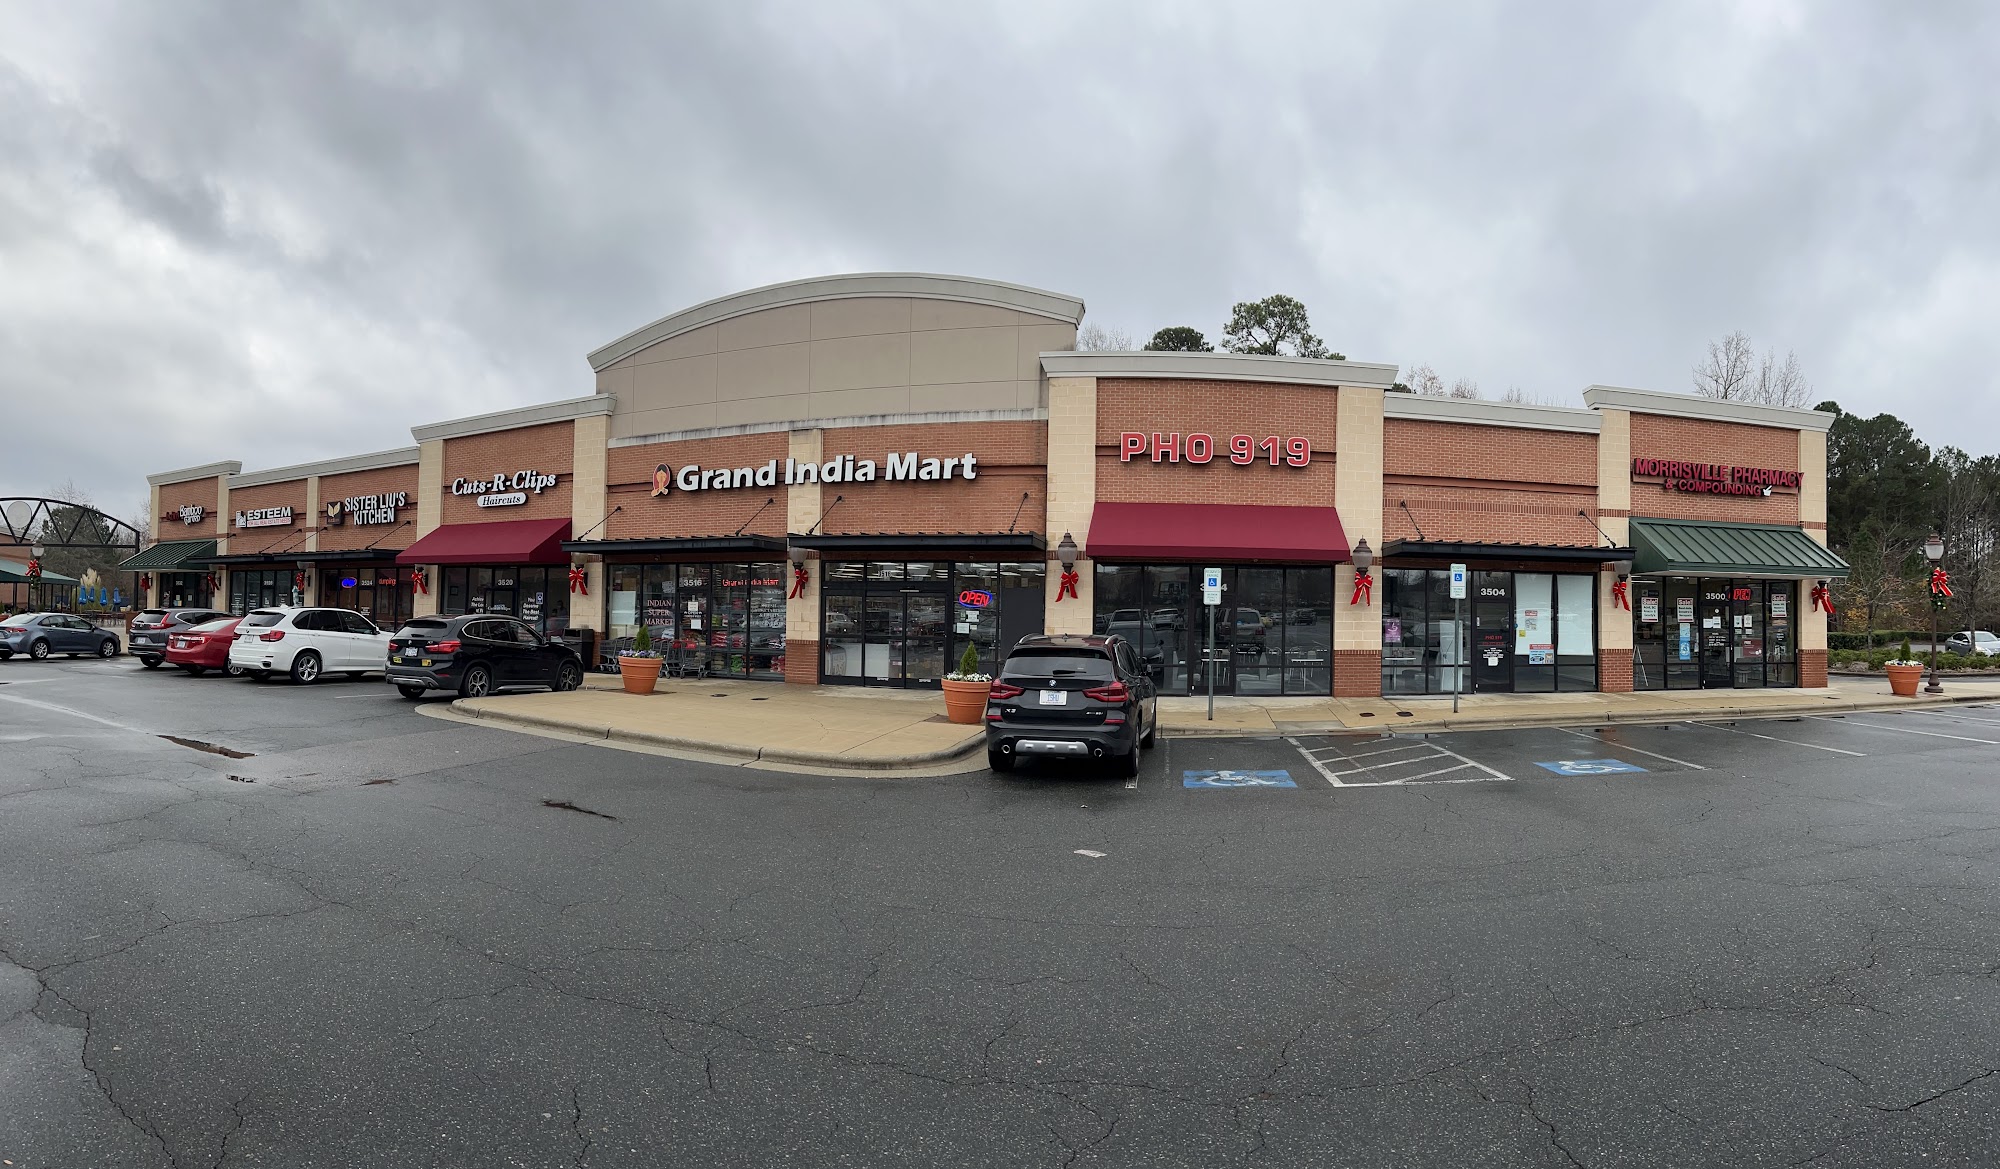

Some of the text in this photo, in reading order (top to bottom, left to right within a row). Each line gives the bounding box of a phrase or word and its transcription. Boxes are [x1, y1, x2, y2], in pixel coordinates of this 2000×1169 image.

[1120, 431, 1312, 468] PHO 919
[676, 451, 978, 491] Grand India Mart
[1634, 457, 1805, 488] MORRISVILLE PHARMACY
[452, 470, 557, 496] Cuts-R-Clips
[1665, 478, 1762, 497] & COMPOUNDING
[344, 491, 406, 512] SISTER LIU'S
[482, 495, 521, 506] Haircuts
[180, 504, 203, 517] Bamboo
[246, 506, 292, 520] ESTEEM
[353, 507, 396, 526] KITCHEN
[683, 579, 703, 587] 3516
[959, 590, 990, 607] OPEN
[1480, 588, 1506, 596] 3504
[1705, 592, 1726, 600] 3500
[647, 599, 672, 607] INDIAN
[648, 608, 670, 616] SUPER
[644, 618, 673, 626] MARKET
